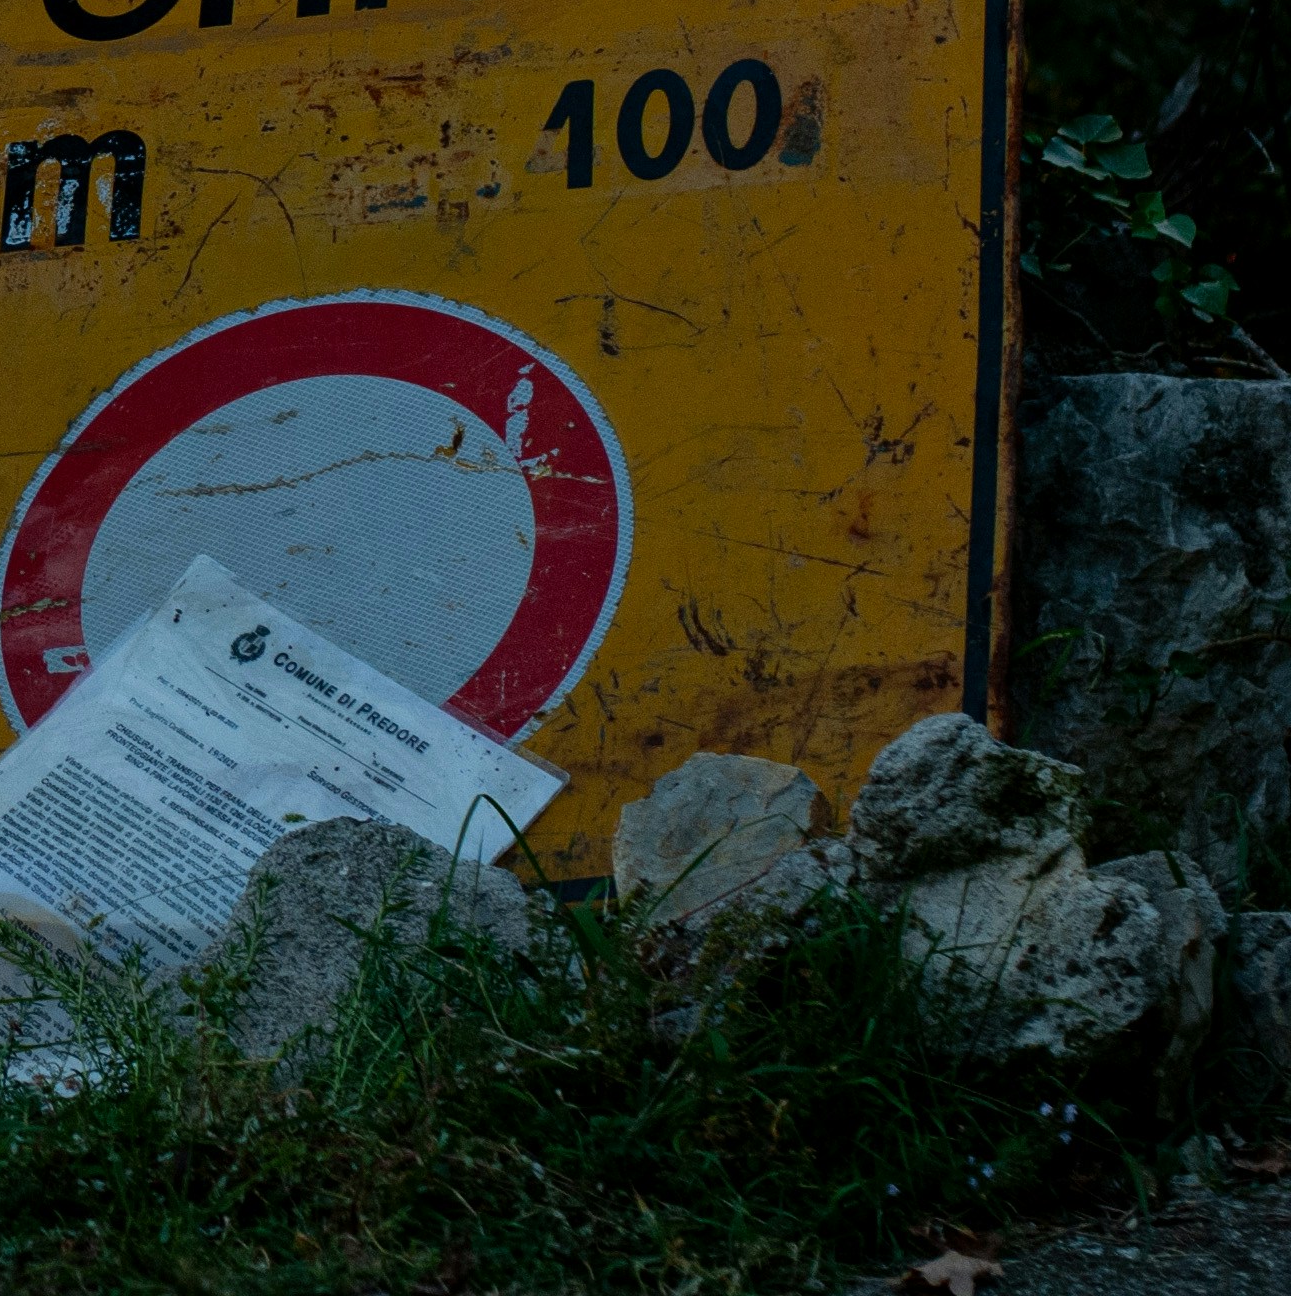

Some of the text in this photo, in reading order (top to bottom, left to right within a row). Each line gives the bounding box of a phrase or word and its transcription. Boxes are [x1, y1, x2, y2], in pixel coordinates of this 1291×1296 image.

[541, 58, 782, 191] 100
[273, 652, 429, 753] COMUNE DI PREDORE
[105, 729, 168, 772] FRONTEGGIANTE
[170, 771, 205, 795] MAPPALI
[220, 802, 229, 810] E
[244, 816, 280, 843] (LOCALIT
[124, 753, 144, 768] SINO
[149, 769, 169, 784] FINE
[166, 782, 197, 802] LAVORI
[195, 798, 206, 808] DI
[204, 804, 231, 824] MESSA
[230, 820, 242, 829] IN
[152, 748, 164, 759] AL
[204, 780, 221, 793] PER
[220, 789, 246, 809] FRANA
[245, 806, 272, 825] DELLA
[168, 801, 225, 839] RESPONSABILE
[223, 836, 240, 849] DEL
